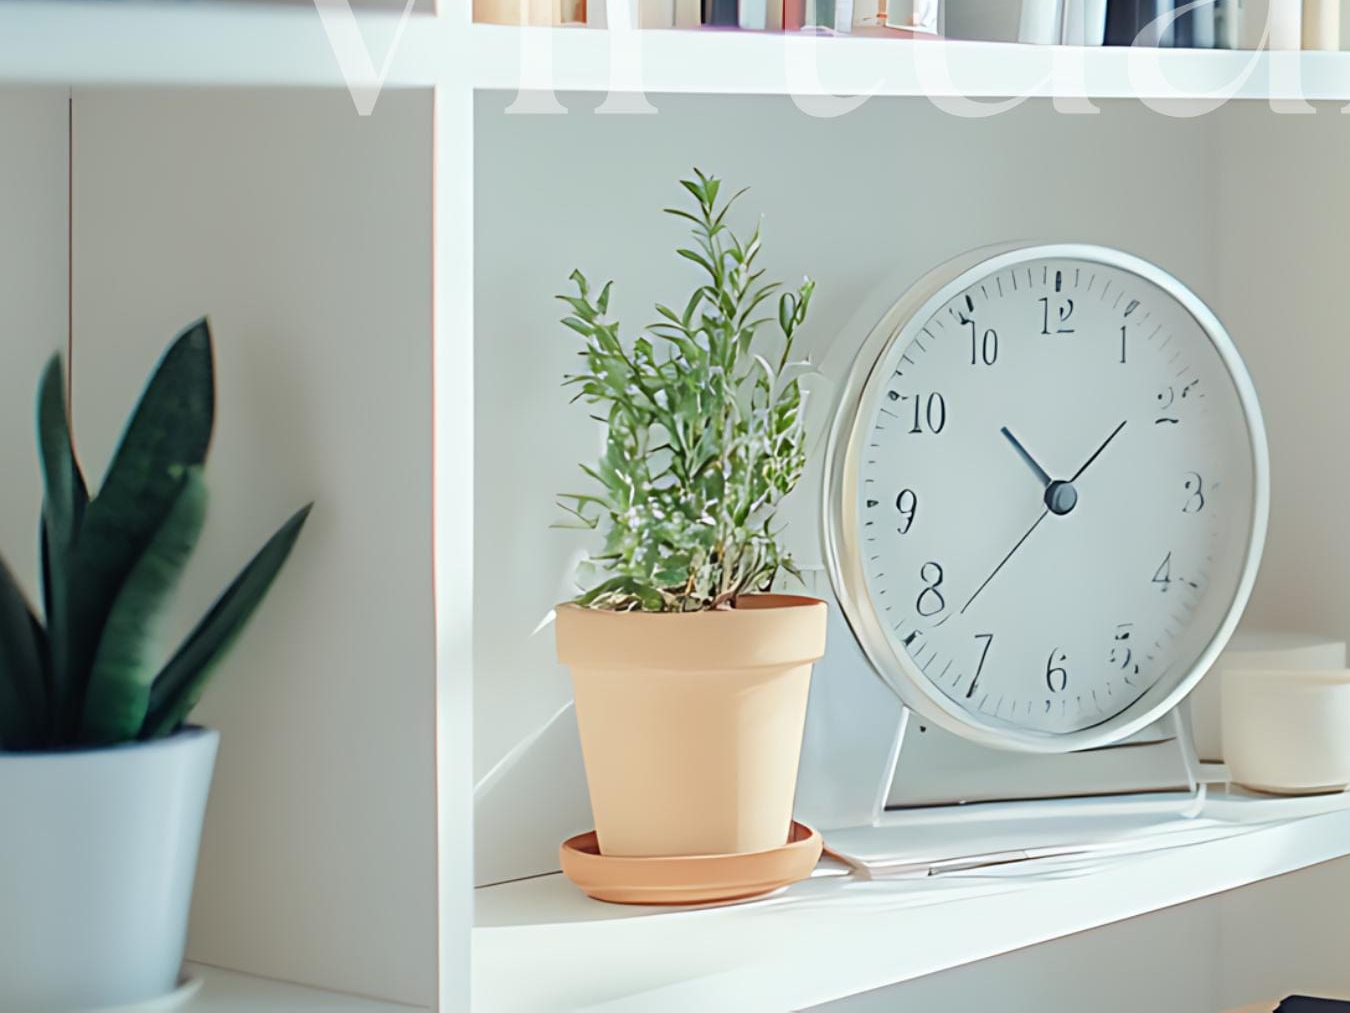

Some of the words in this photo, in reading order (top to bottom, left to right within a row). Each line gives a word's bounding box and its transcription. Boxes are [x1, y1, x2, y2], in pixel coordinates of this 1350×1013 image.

[1119, 325, 1127, 364] 1
[907, 391, 947, 435] 10
[895, 488, 918, 534] 9
[1182, 471, 1205, 513] 3
[916, 561, 946, 617] 8
[1151, 551, 1172, 593] 4
[965, 633, 994, 699] 7
[1046, 647, 1068, 693] 6
